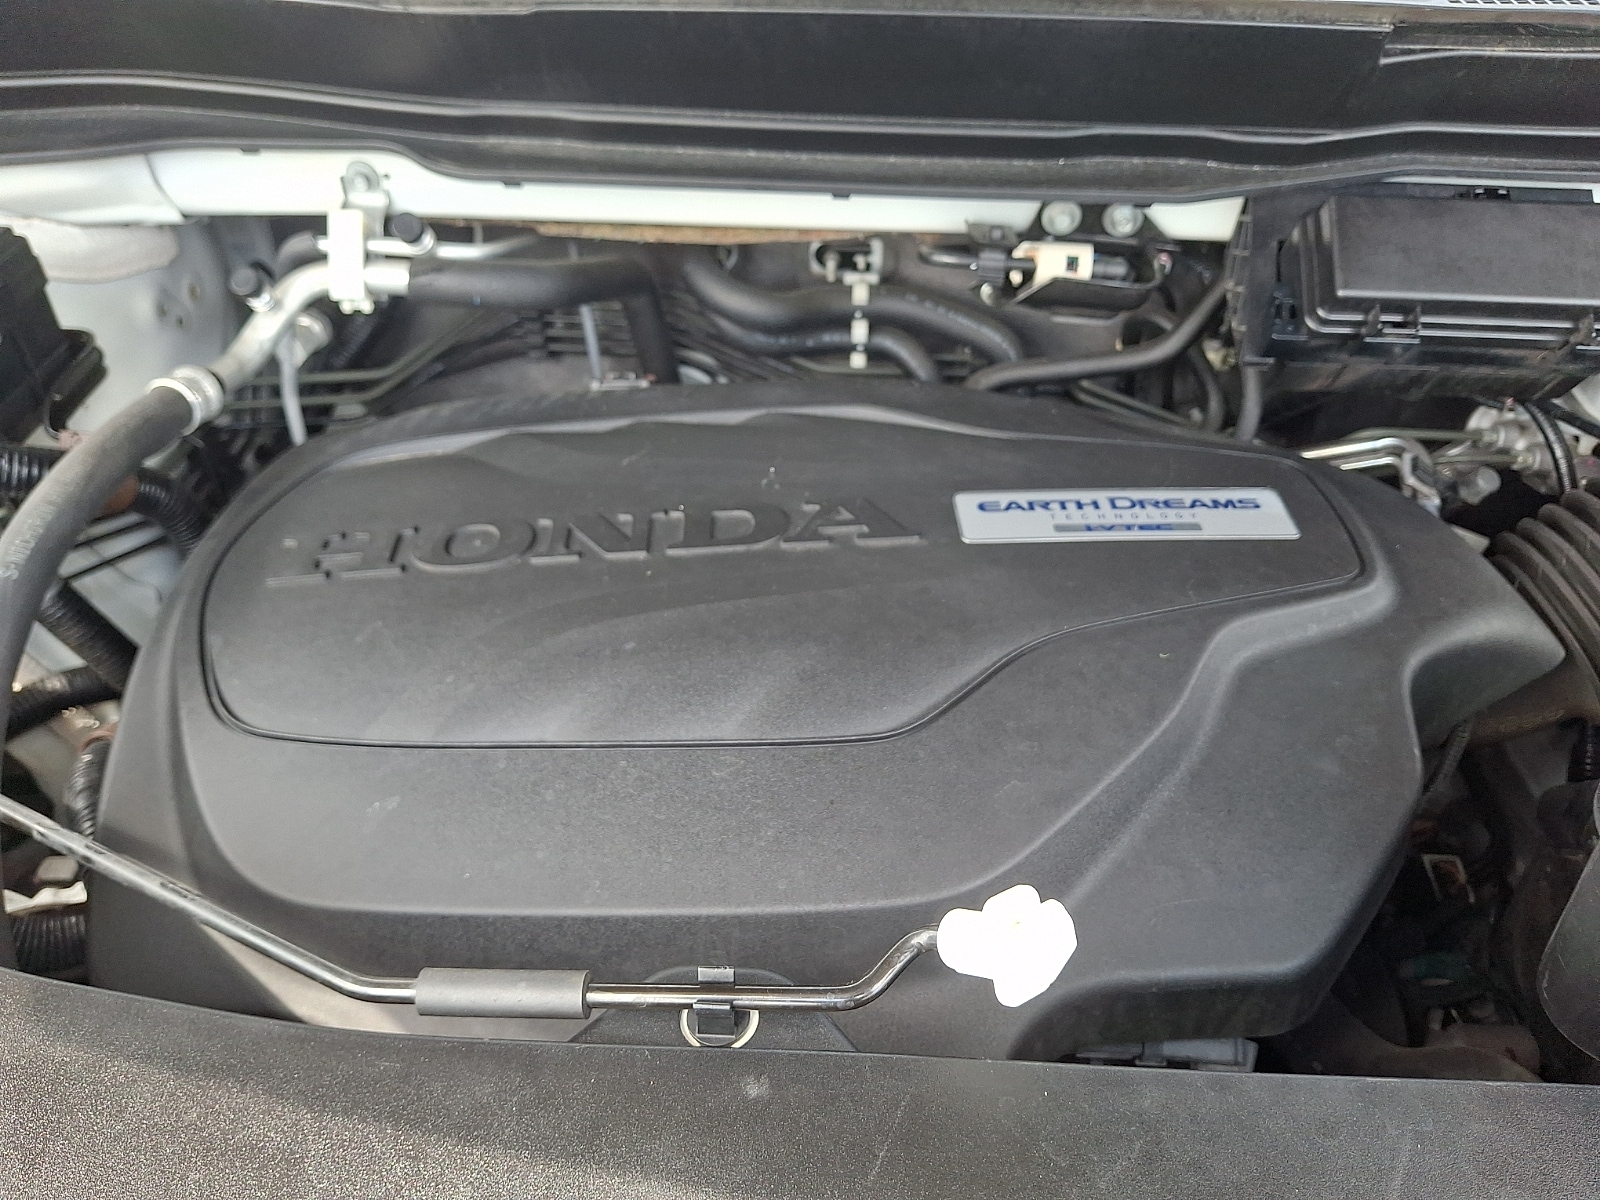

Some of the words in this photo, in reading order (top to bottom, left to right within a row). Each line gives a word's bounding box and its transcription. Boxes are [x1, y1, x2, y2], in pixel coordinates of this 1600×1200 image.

[978, 500, 1101, 512] EARTH
[1107, 496, 1262, 509] DREAMS
[1051, 512, 1200, 520] TECHNOLOGY
[265, 499, 923, 586] HONDA
